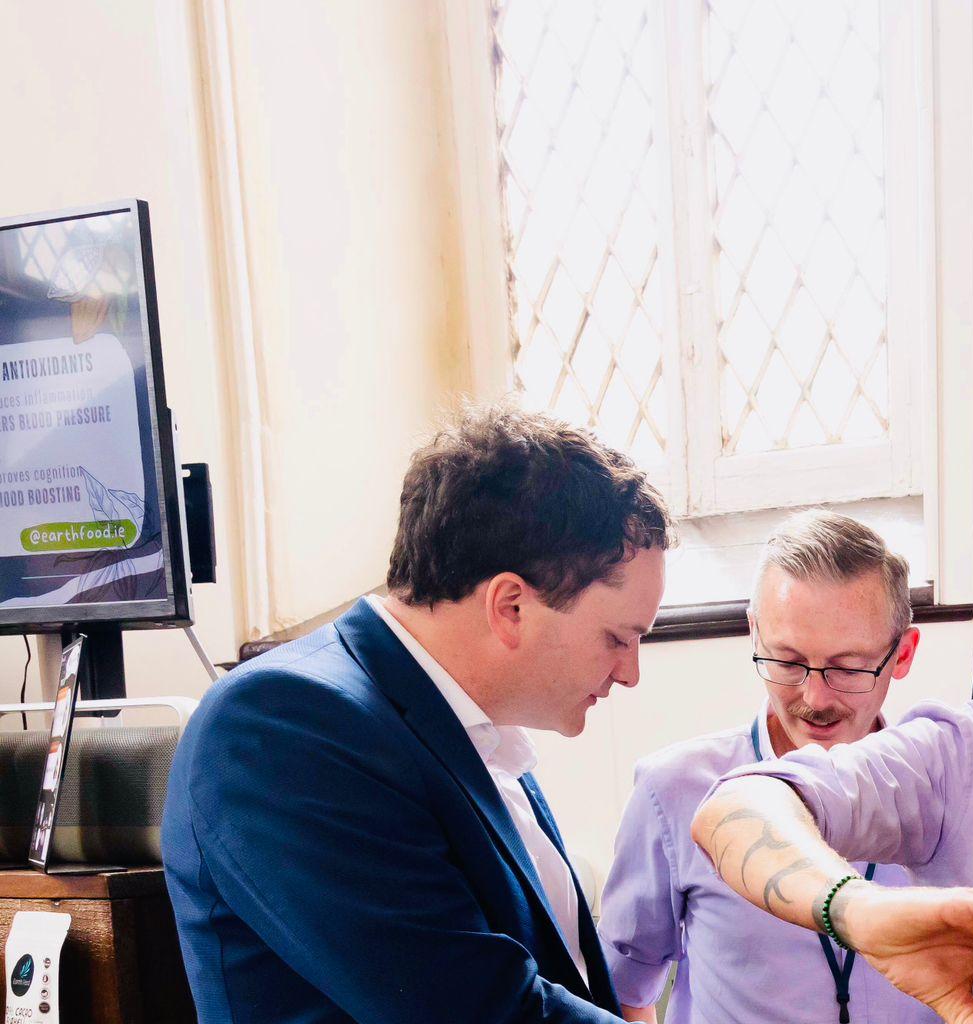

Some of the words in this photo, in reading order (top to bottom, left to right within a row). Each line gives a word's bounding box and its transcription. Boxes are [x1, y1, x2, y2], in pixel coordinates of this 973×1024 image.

[2, 353, 94, 382] ANTIOXIDANTS
[19, 411, 53, 432] BLOOD
[56, 405, 112, 427] PRESSURE
[33, 465, 83, 484] cognition
[27, 485, 81, 506] BOOSTING
[29, 525, 126, 545] @earthfood.ie
